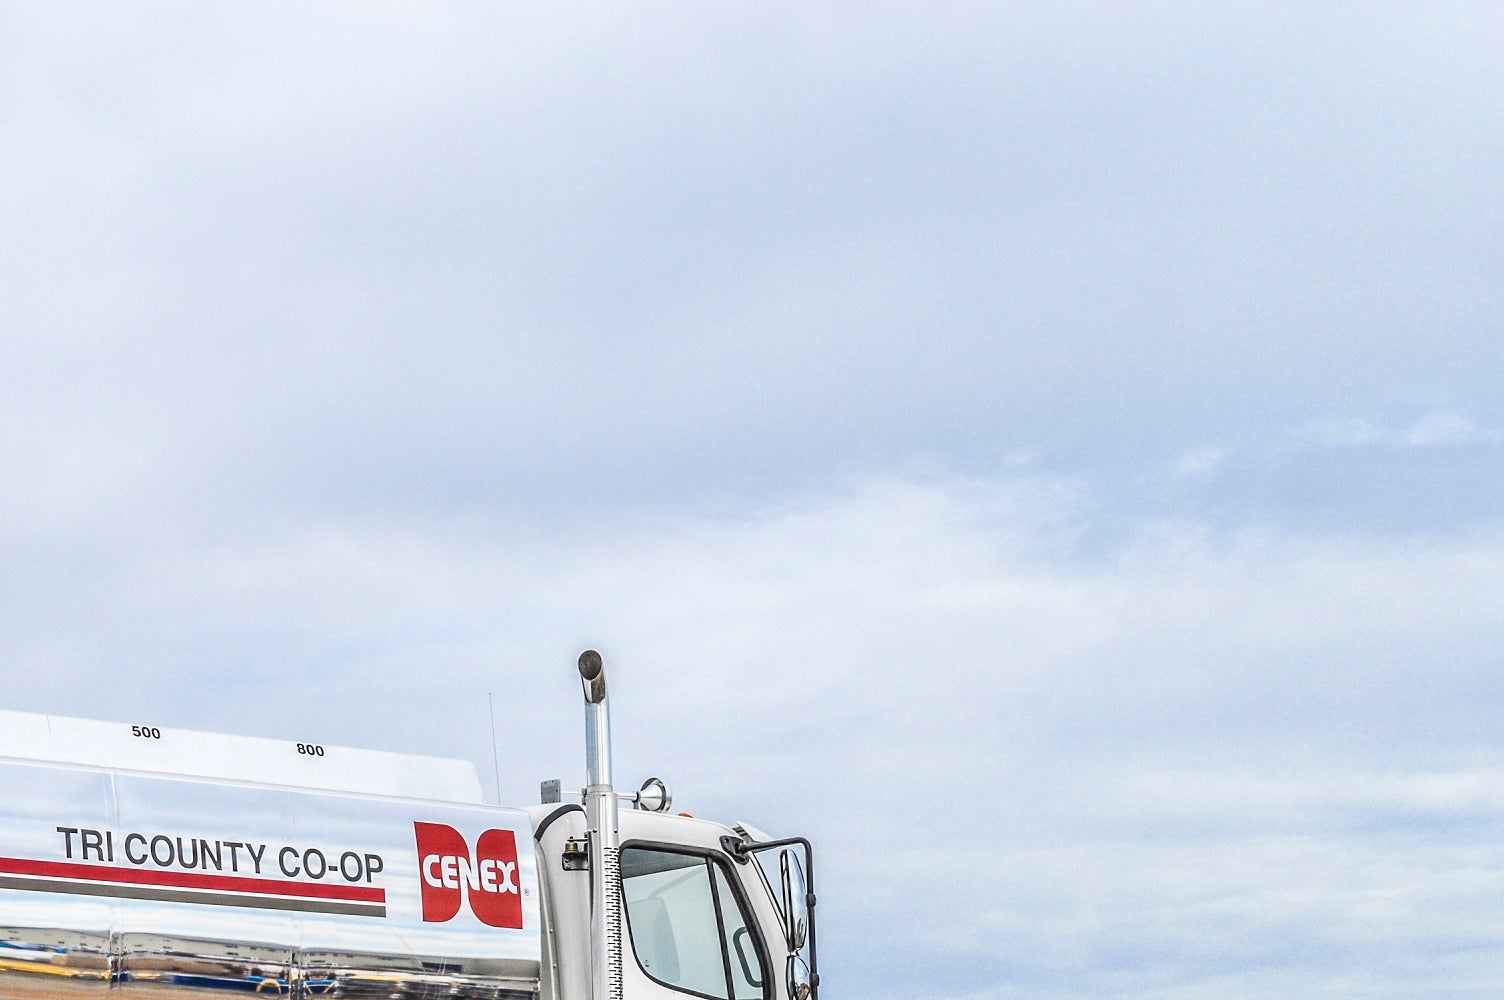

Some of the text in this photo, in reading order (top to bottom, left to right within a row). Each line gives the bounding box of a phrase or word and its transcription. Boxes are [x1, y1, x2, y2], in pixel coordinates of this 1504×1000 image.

[131, 725, 161, 740] 500
[296, 743, 325, 757] 800
[56, 826, 384, 883] TRI COUNTY CO-OP
[422, 854, 518, 894] CENEX
